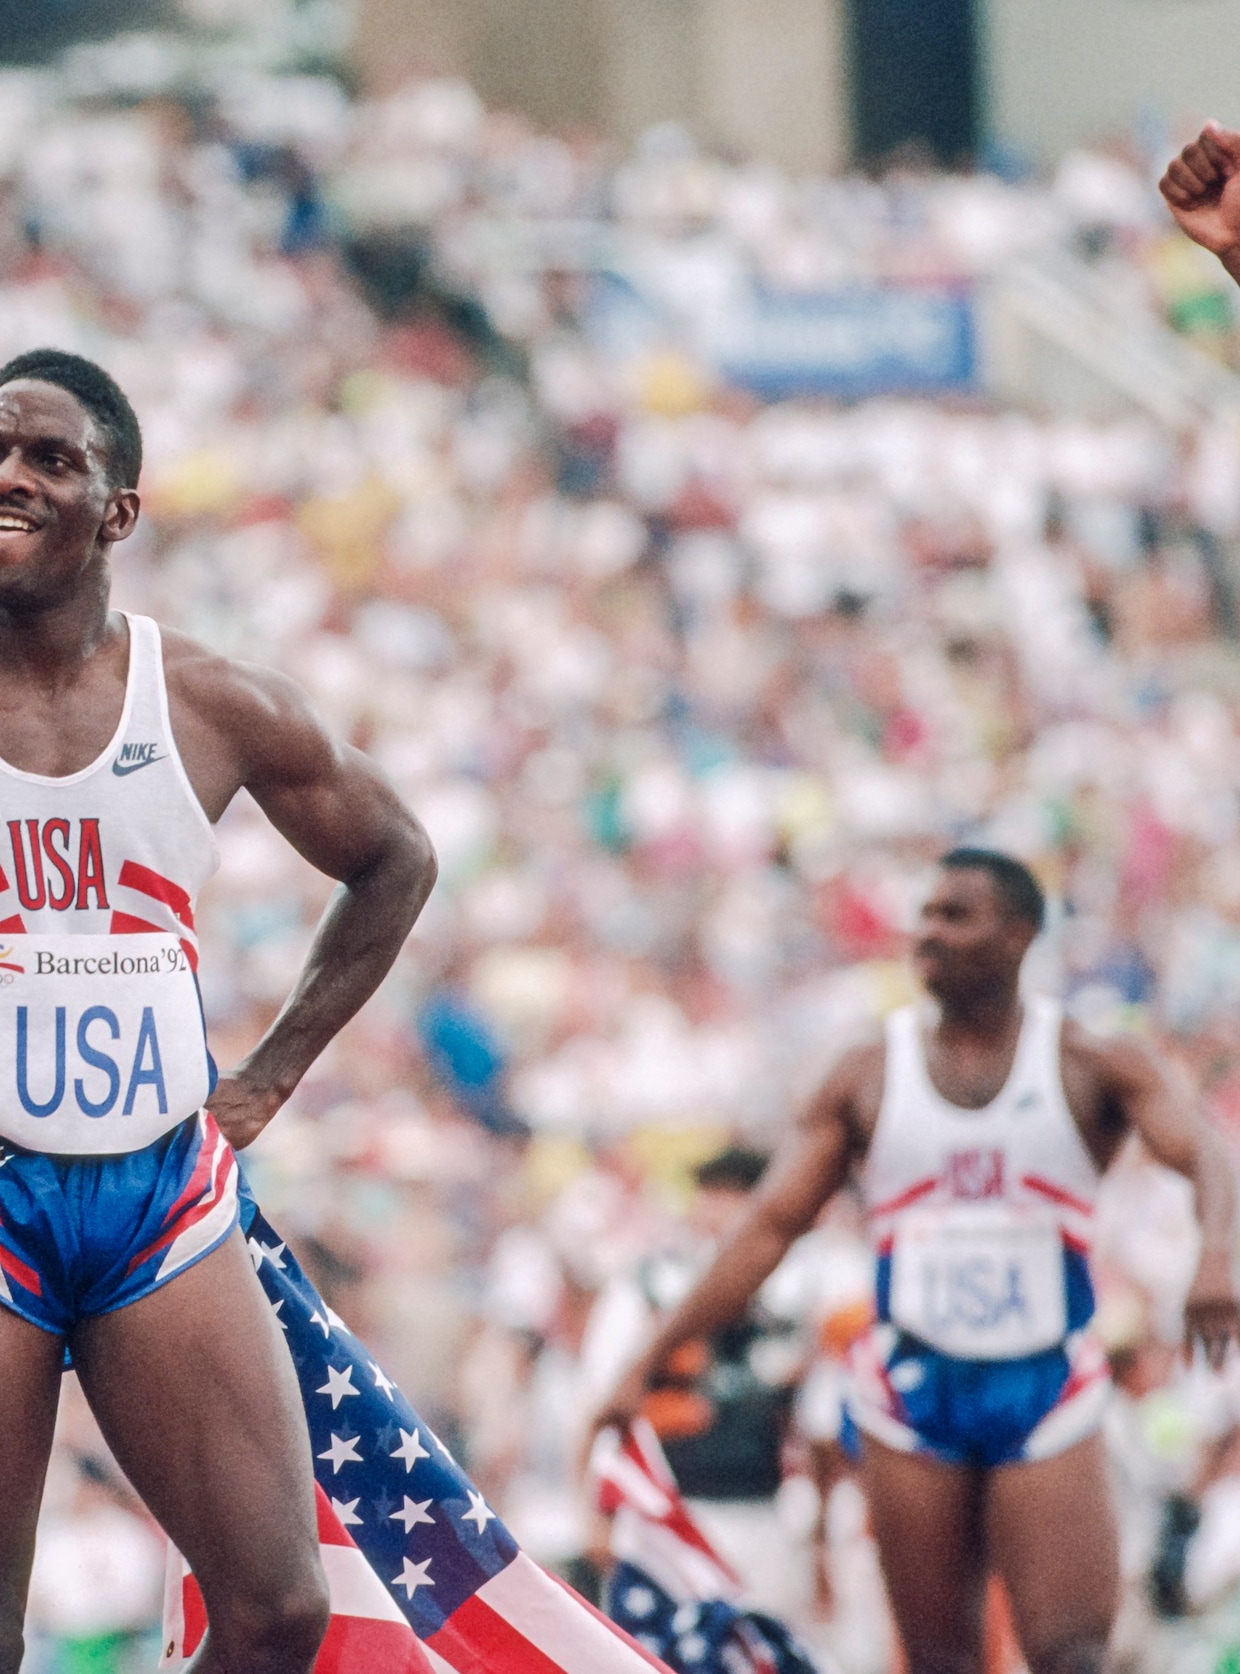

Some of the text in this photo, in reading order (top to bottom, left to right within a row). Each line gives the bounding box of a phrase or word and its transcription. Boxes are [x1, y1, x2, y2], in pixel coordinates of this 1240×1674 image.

[119, 743, 158, 761] NIKE
[7, 817, 110, 911] USA
[16, 1005, 169, 1119] USA
